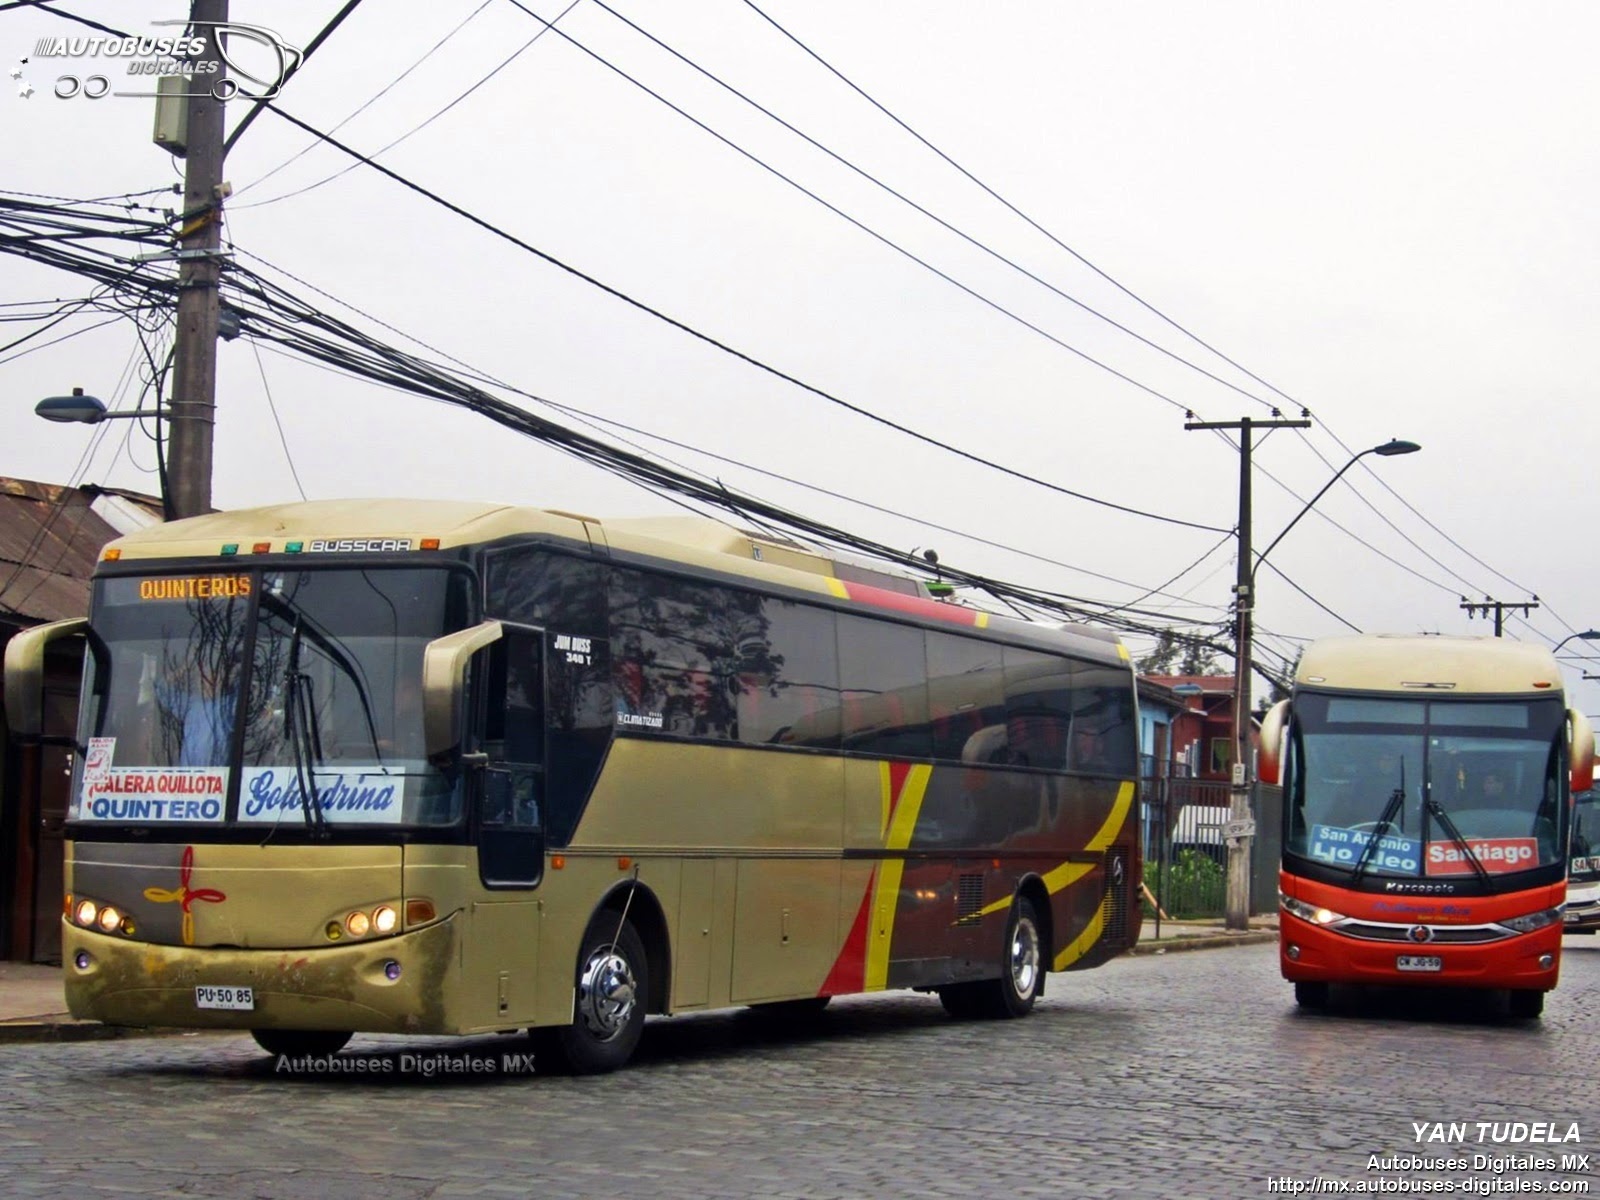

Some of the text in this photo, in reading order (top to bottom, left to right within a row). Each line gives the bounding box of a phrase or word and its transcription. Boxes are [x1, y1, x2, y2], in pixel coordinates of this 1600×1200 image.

[310, 540, 411, 552] BUSSCAR
[139, 577, 251, 599] QUINTEROS
[94, 775, 223, 794] CALERA QUILLOTA
[92, 798, 220, 819] QUINTERO
[1320, 828, 1411, 852] San Anonio
